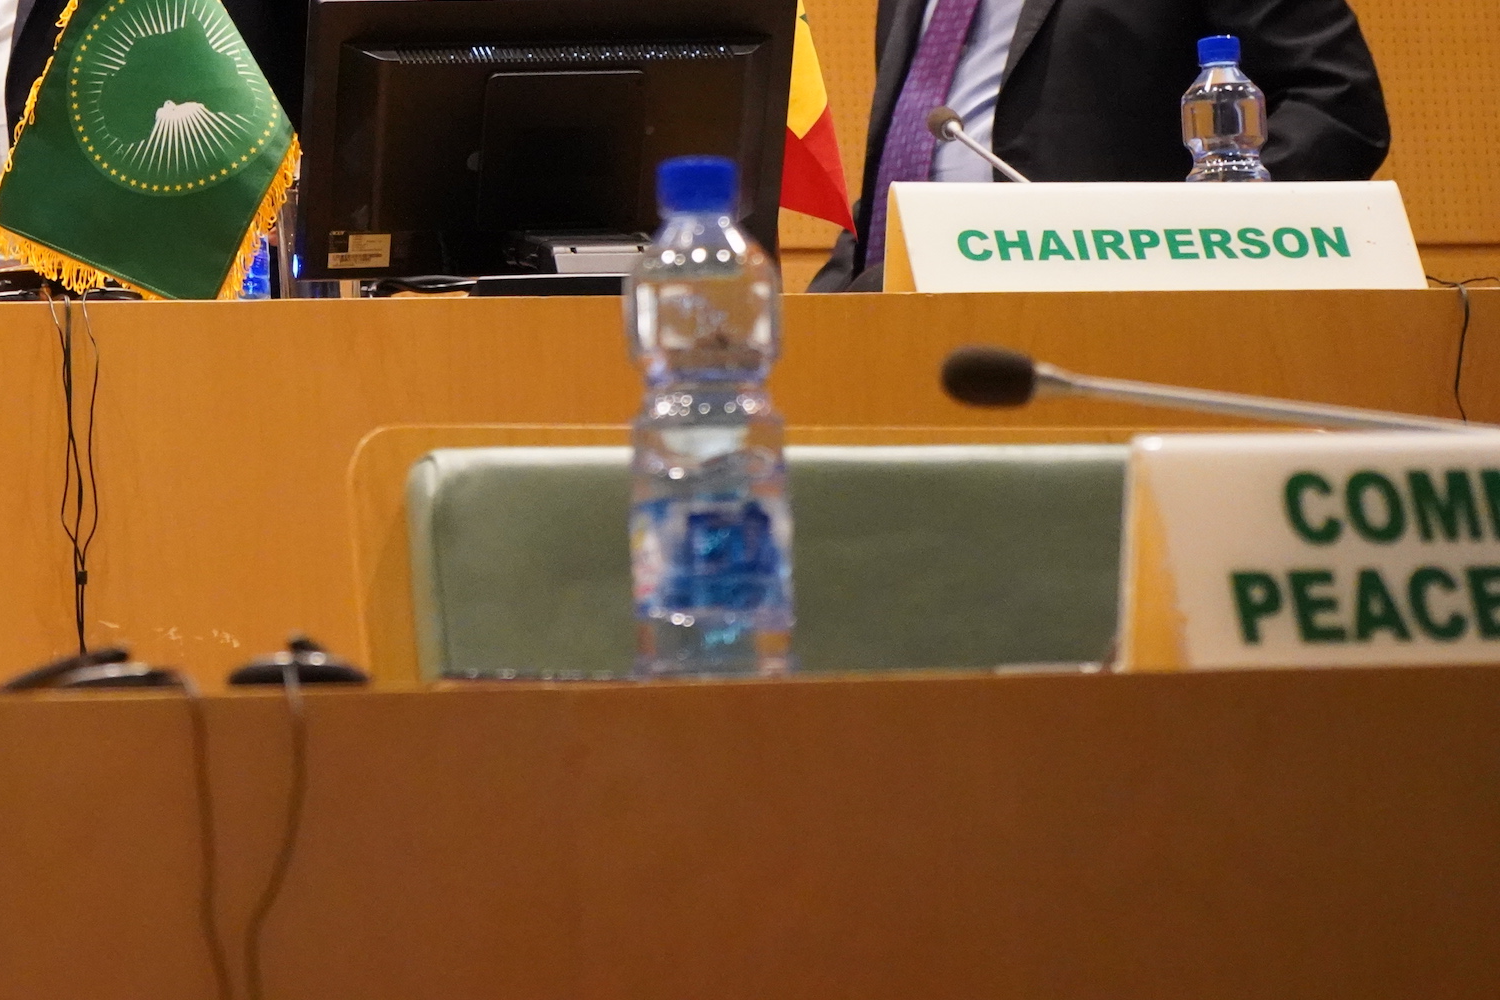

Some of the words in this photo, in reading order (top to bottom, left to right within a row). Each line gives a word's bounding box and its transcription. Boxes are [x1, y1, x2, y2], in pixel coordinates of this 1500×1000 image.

[956, 225, 1352, 263] CHAIRPERSON
[1283, 468, 1500, 545] COM
[1229, 565, 1500, 644] PEACE
